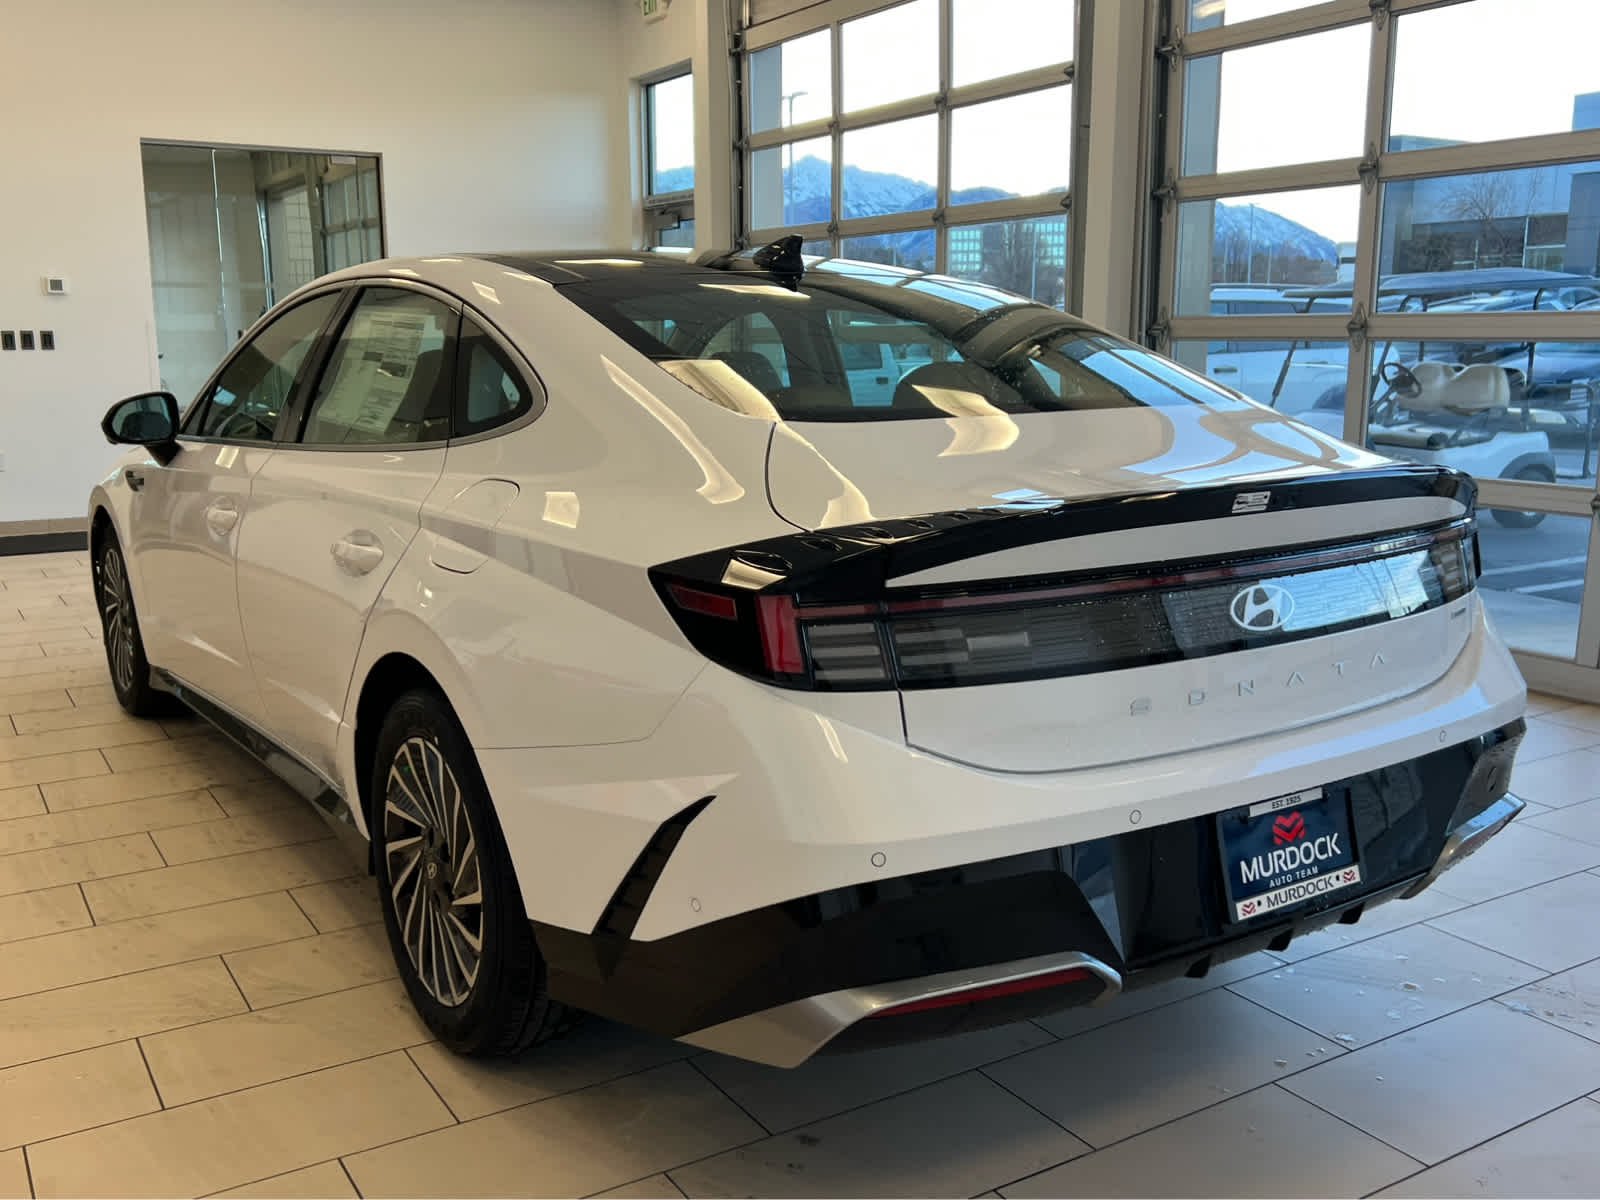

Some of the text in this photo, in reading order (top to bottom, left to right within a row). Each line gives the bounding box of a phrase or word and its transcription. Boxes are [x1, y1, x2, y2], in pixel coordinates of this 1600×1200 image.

[1130, 648, 1385, 717] SONATA
[1240, 833, 1341, 883] MURDOCK
[1270, 866, 1318, 888] AUTO TEAM
[1266, 876, 1334, 909] MURDOCK
